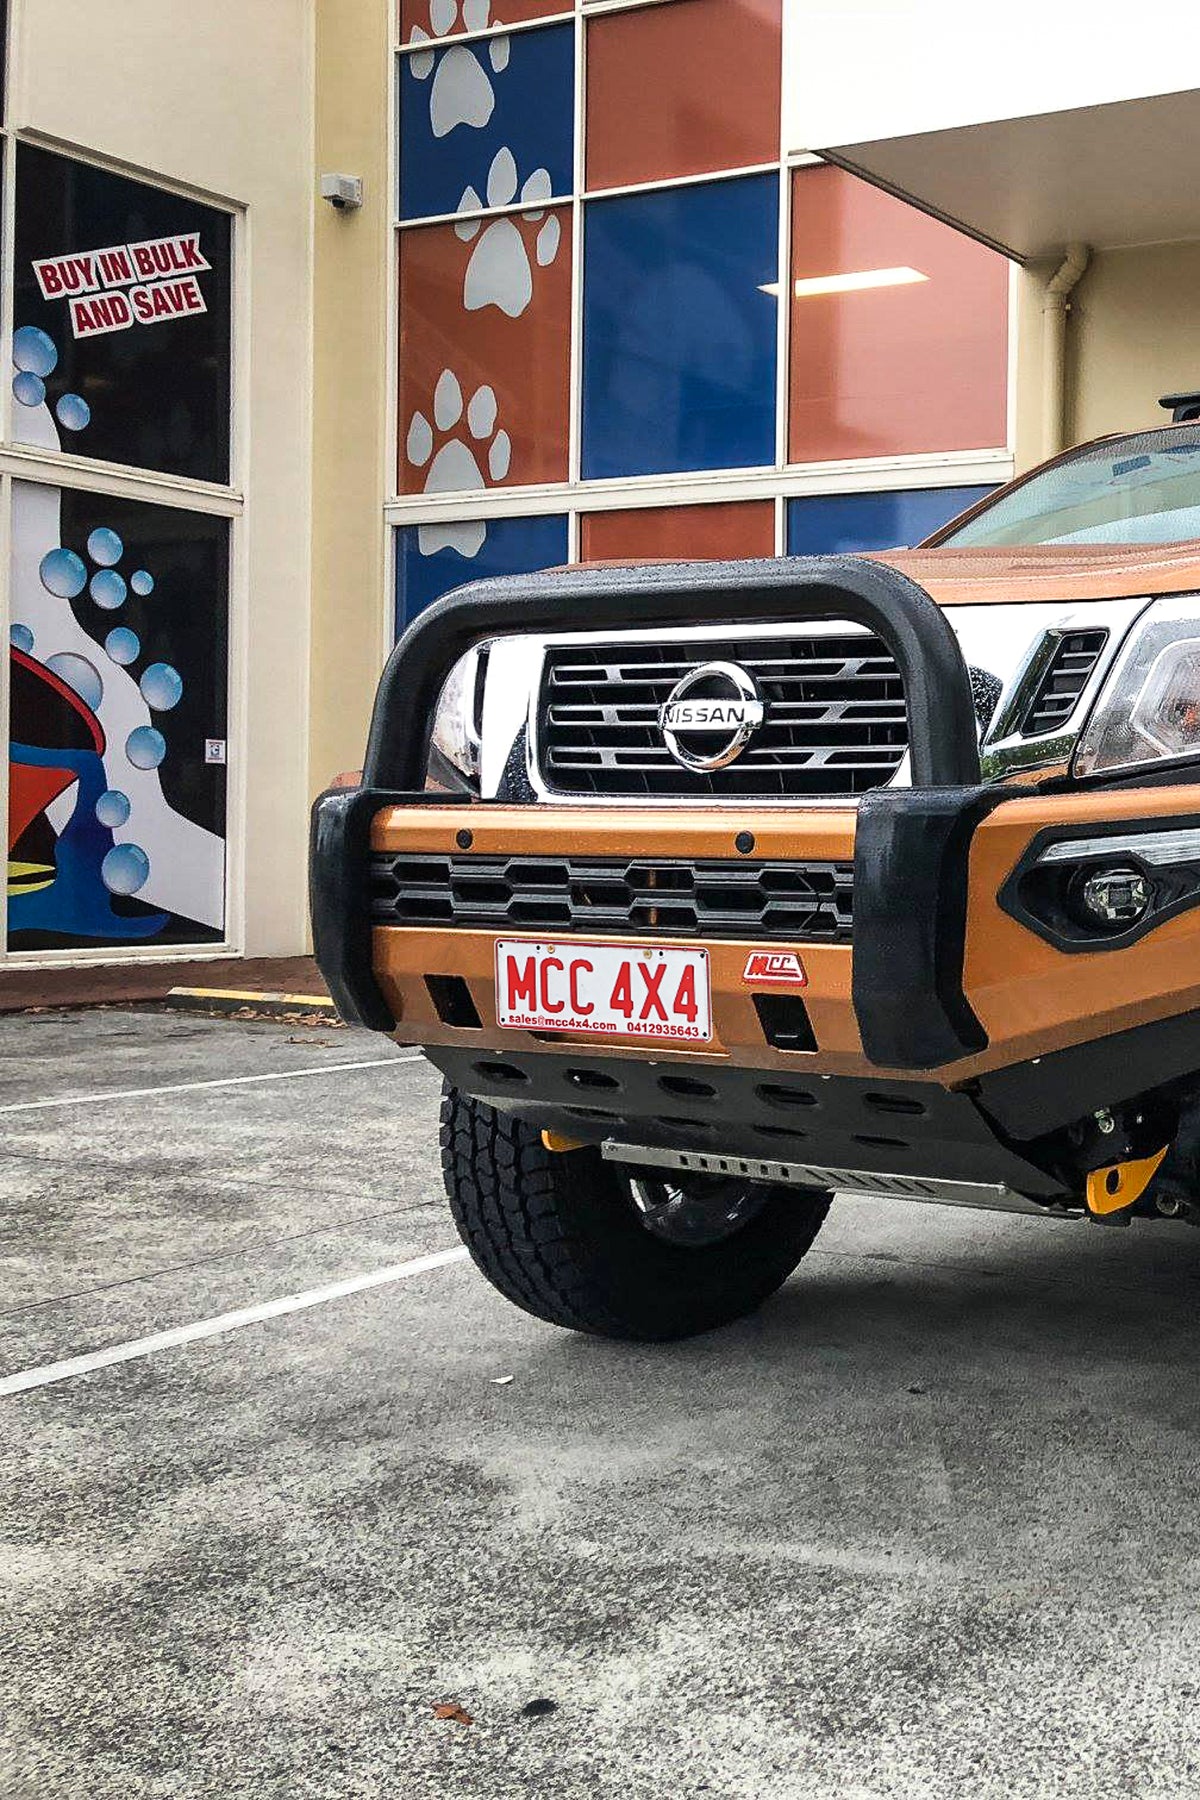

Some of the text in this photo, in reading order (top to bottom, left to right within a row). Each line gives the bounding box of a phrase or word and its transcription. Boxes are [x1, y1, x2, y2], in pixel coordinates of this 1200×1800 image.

[38, 239, 203, 294] BUY IN BULK
[74, 281, 202, 332] AND SAVE
[666, 707, 745, 723] NISSAN
[507, 955, 698, 1022] MCC 4X4
[508, 1014, 699, 1037] sales@mcc4x4.com 0412935643
